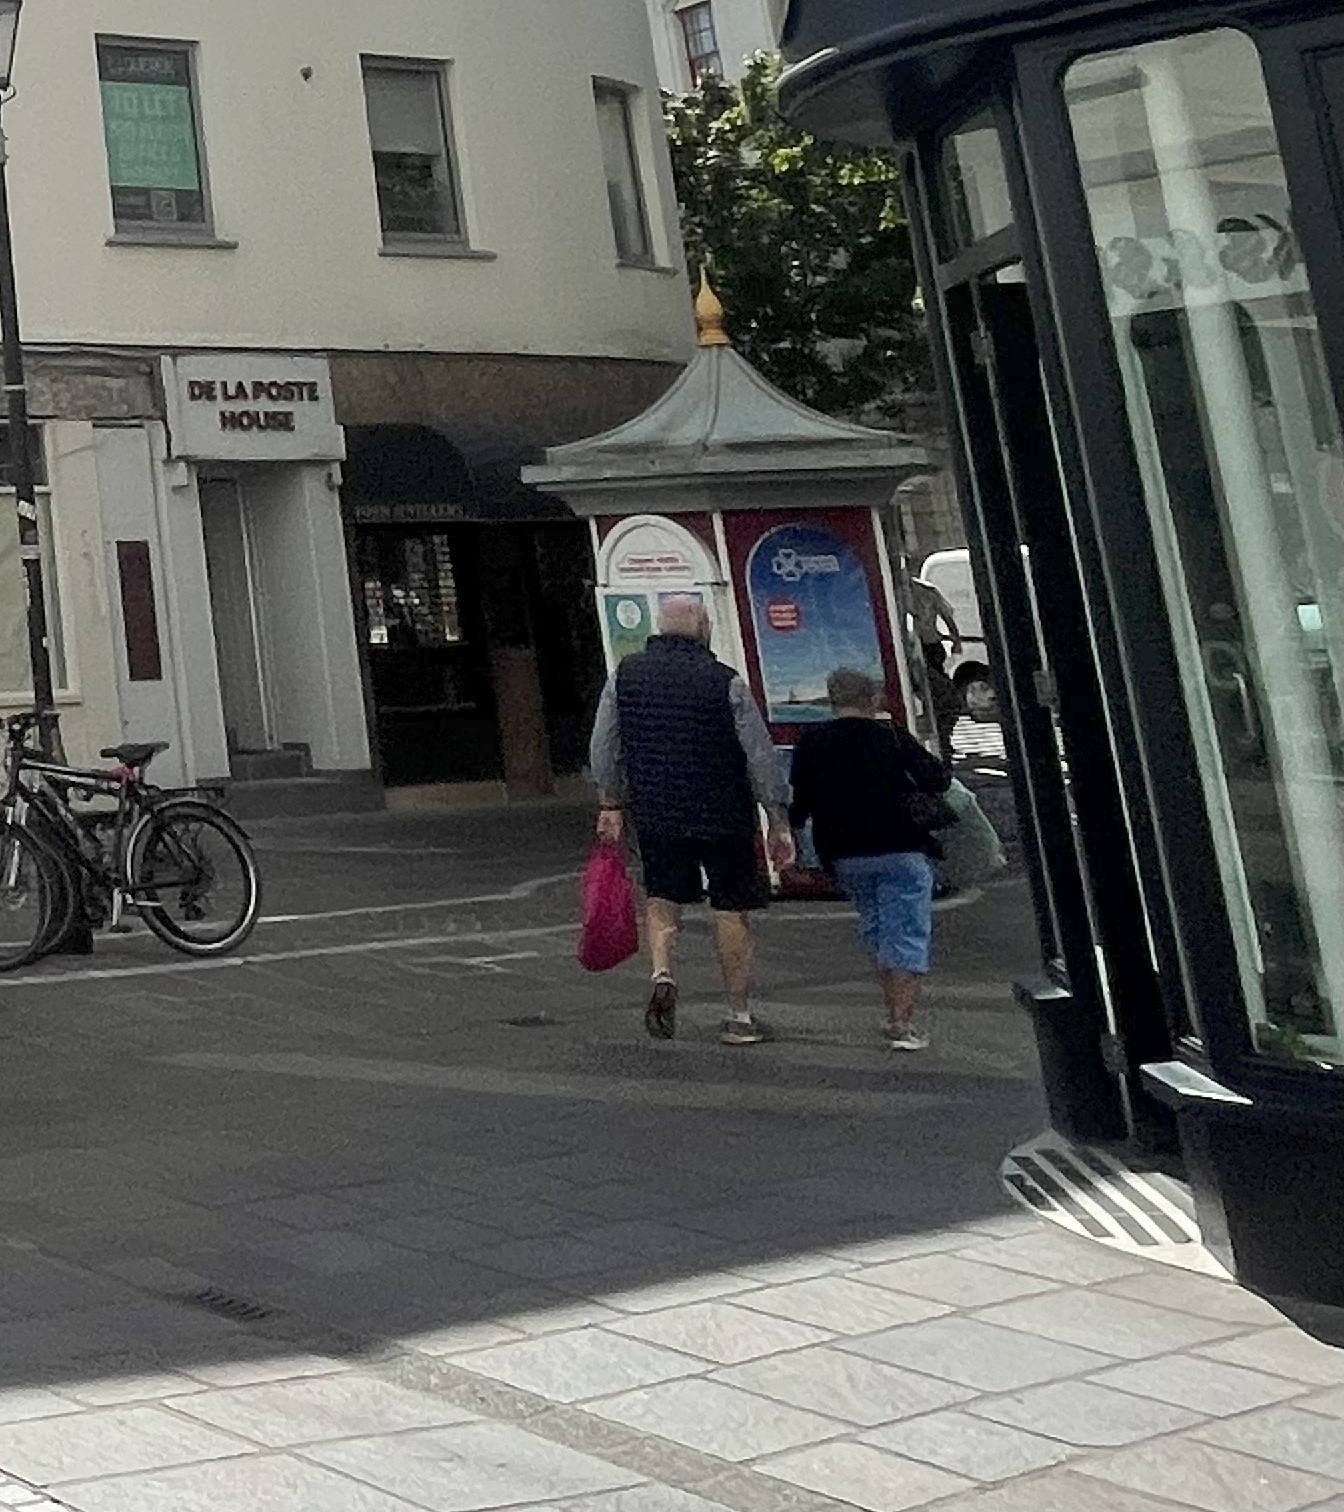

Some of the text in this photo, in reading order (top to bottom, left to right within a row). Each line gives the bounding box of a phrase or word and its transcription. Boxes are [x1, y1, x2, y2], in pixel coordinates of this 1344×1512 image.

[188, 380, 319, 402] DE LA POSTE
[219, 410, 296, 432] HOUSE
